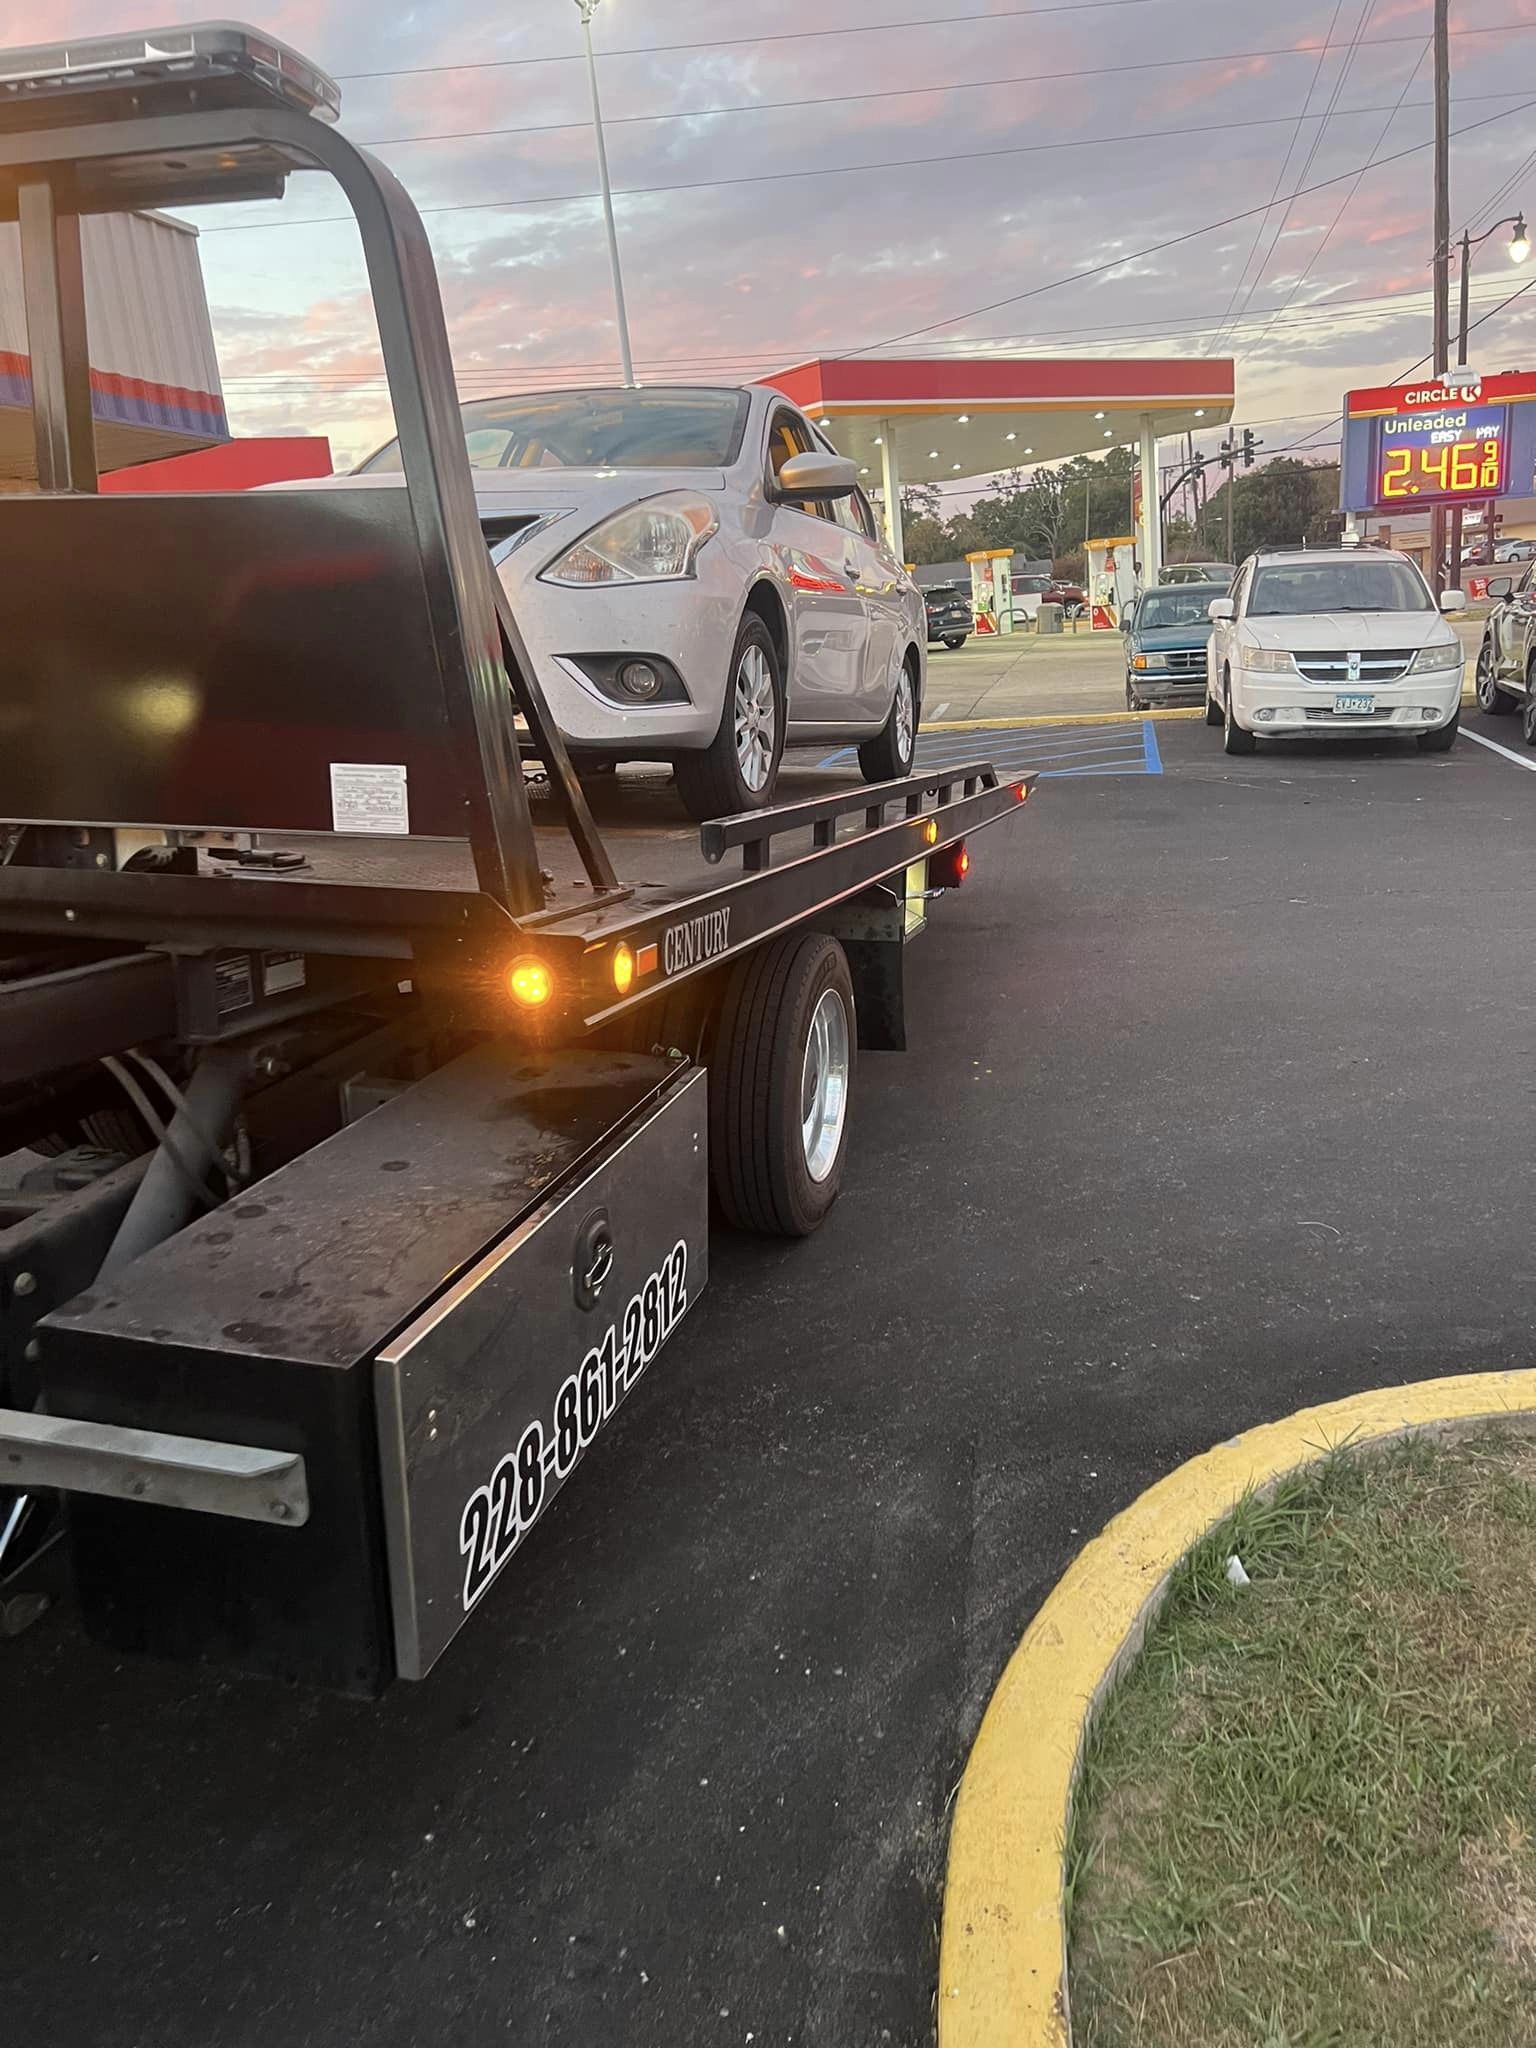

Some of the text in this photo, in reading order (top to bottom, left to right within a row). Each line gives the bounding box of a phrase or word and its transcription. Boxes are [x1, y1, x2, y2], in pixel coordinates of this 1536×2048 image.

[1405, 386, 1482, 405] CIRCLE K
[1384, 413, 1467, 434] Unleaded
[1430, 425, 1500, 444] EASY PAY
[664, 906, 732, 976] CENTURY
[459, 1239, 688, 1612] 228-861-2812
